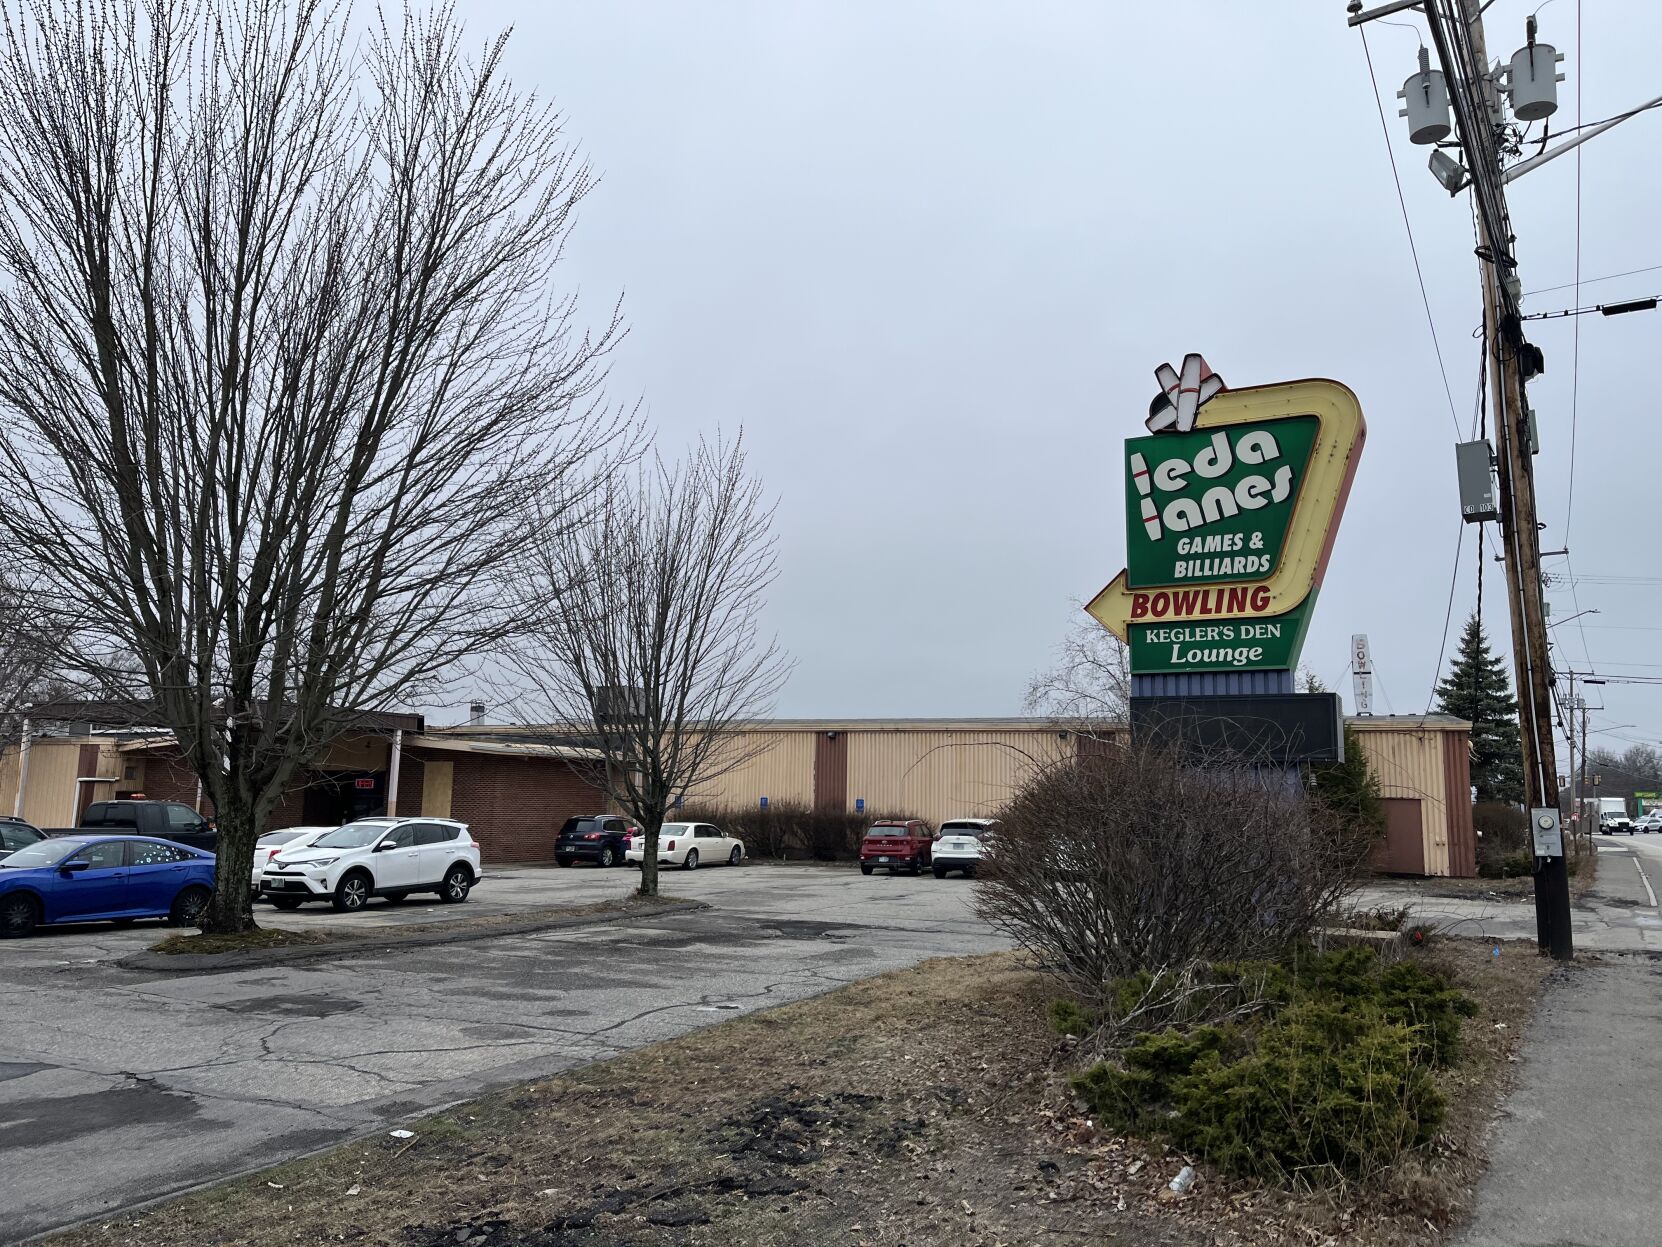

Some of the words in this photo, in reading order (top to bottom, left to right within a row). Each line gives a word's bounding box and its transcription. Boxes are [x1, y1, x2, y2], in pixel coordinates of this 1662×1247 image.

[1177, 533, 1243, 555] GAMES
[1249, 531, 1265, 549] &
[1174, 554, 1270, 579] BILLIARDS
[1130, 586, 1271, 619] BOWLING
[1146, 624, 1235, 643] KEGLER'S
[1240, 623, 1281, 639] DEN
[1170, 644, 1263, 666] Lounge
